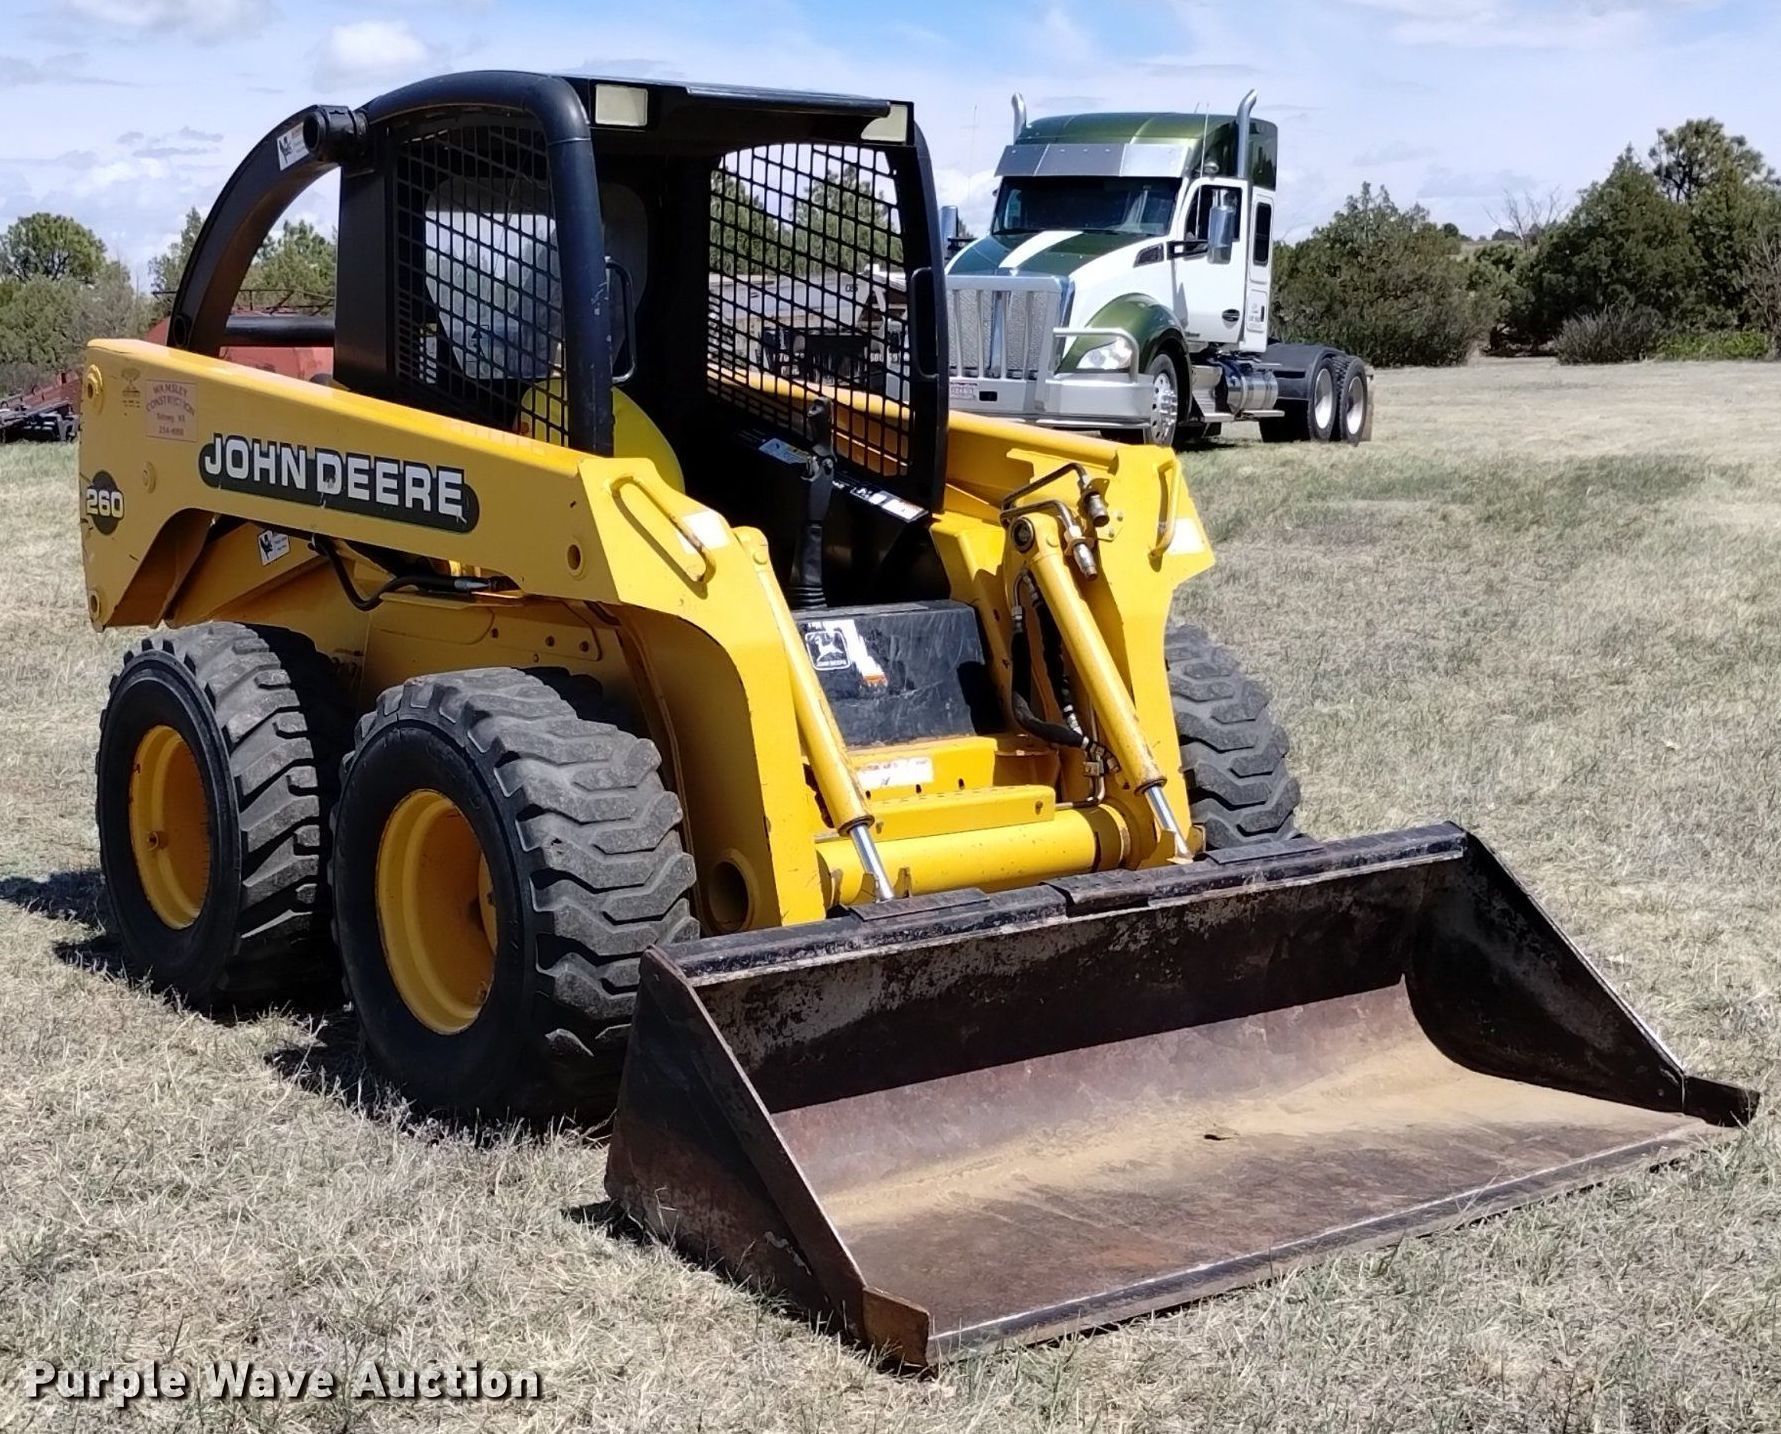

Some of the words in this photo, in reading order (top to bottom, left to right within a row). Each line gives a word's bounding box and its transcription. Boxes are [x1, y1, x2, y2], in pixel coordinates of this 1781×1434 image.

[86, 488, 124, 519] 260
[204, 436, 307, 491] JOHN
[316, 450, 464, 517] DEERE
